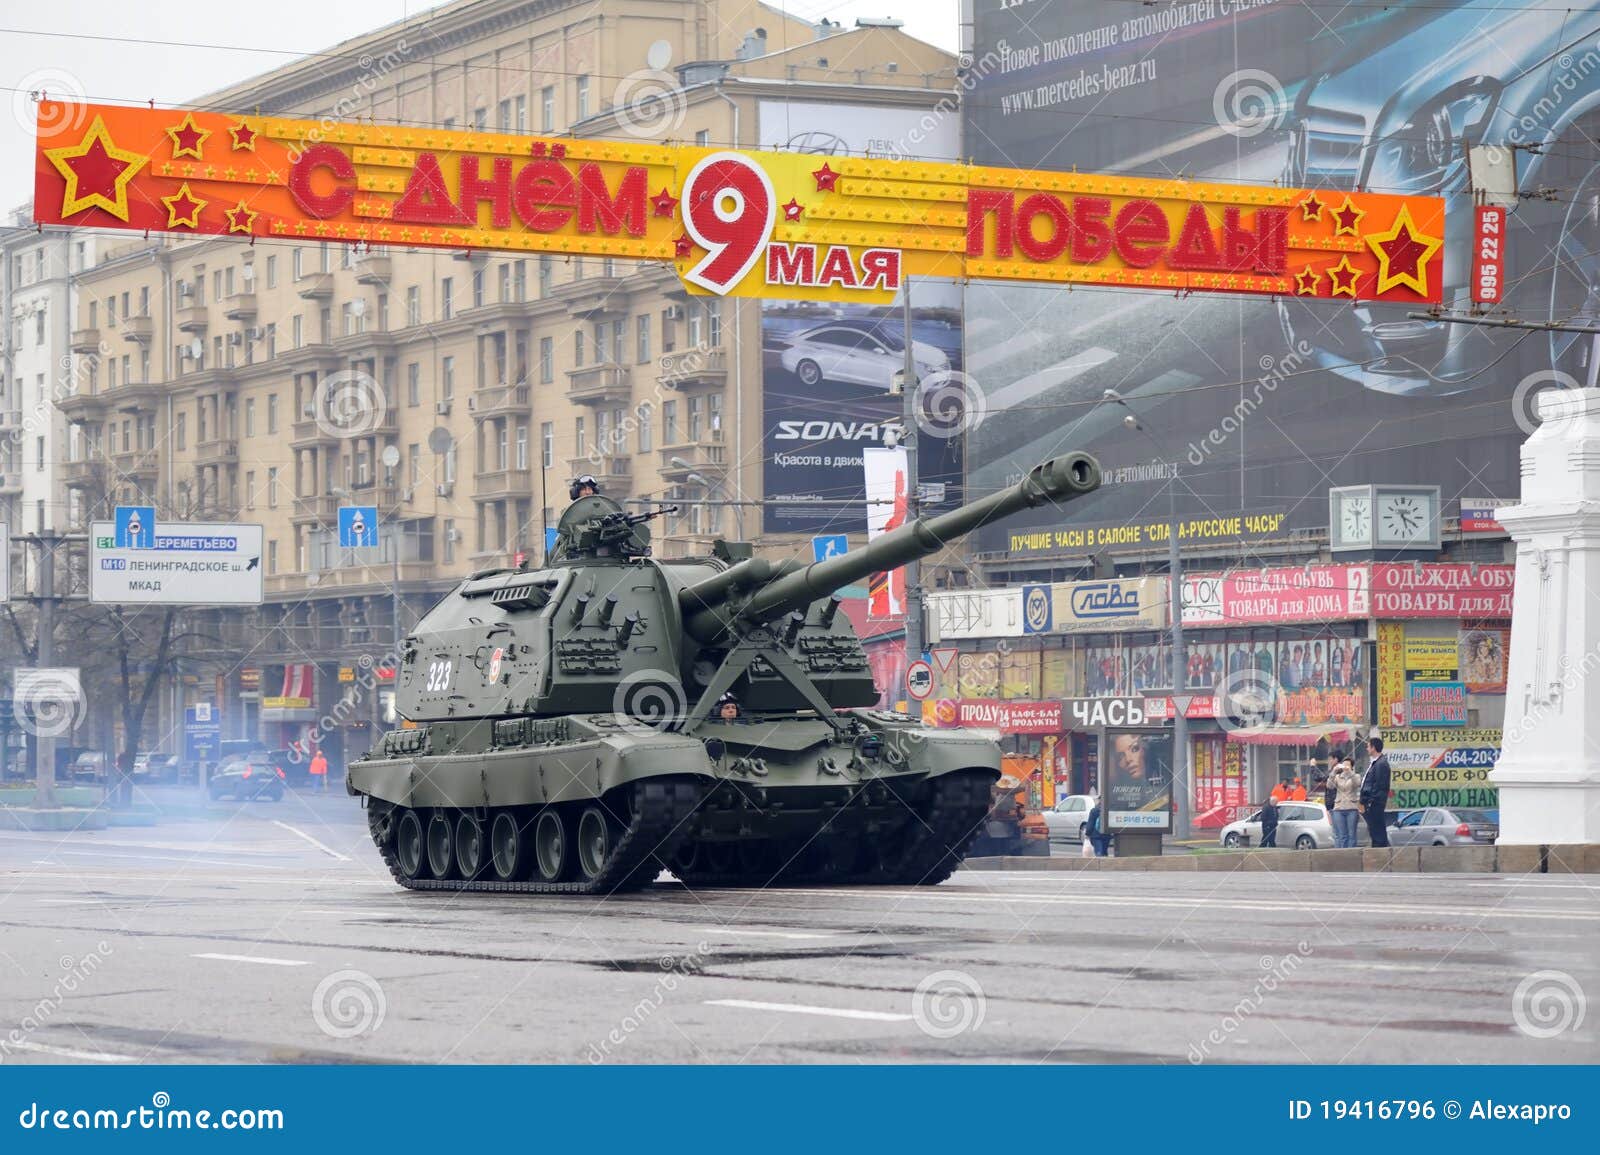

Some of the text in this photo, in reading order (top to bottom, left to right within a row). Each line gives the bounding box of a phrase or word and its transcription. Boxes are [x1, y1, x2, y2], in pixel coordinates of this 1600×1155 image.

[1000, 46, 1040, 74] Новое
[1044, 24, 1119, 62] поколение
[1122, 1, 1215, 42] автомобилей
[1000, 59, 1157, 116] www.mercedes-benz.ru
[288, 142, 358, 219] С
[681, 152, 902, 295] 9 МАЯ
[966, 189, 1289, 274] ПОБЕДЫ
[1480, 211, 1499, 299] 995 22 25
[774, 420, 904, 441] SONAT
[774, 453, 865, 468] Красота в движ
[1011, 532, 1052, 552] ЛУЧШИЕ
[1055, 530, 1084, 547] ЧАСЫ
[1087, 530, 1094, 546] В
[1098, 525, 1141, 545] САЛОНЕ
[1144, 517, 1241, 541] “СЛАА-РУССКИЕ
[102, 560, 125, 570] M10
[129, 561, 228, 572] ЛЕНИНГРАДСКОЕ
[129, 581, 161, 592] МКАД
[1235, 574, 1289, 594] ОДЕЖДА
[1352, 570, 1363, 601] 2
[1386, 568, 1514, 590] ОДЕЖДА ОБУ
[1182, 579, 1221, 604] СТОК
[1229, 598, 1278, 618] ТОВАРЫ
[1281, 601, 1303, 616] для
[1306, 595, 1342, 614] ДОМА
[1375, 593, 1455, 611] ТОВАРЫ
[1459, 599, 1494, 614] для
[426, 661, 452, 692] 323
[961, 704, 1000, 723] ПРОДУ
[1011, 709, 1061, 718] КАФЕ-БАР
[1011, 718, 1058, 726] ПРОДУКТЫ
[1380, 731, 1439, 743] РЕМОНТ
[1392, 769, 1492, 782] РОЧНОЕ ФО
[1397, 788, 1499, 808] SECOND HAN
